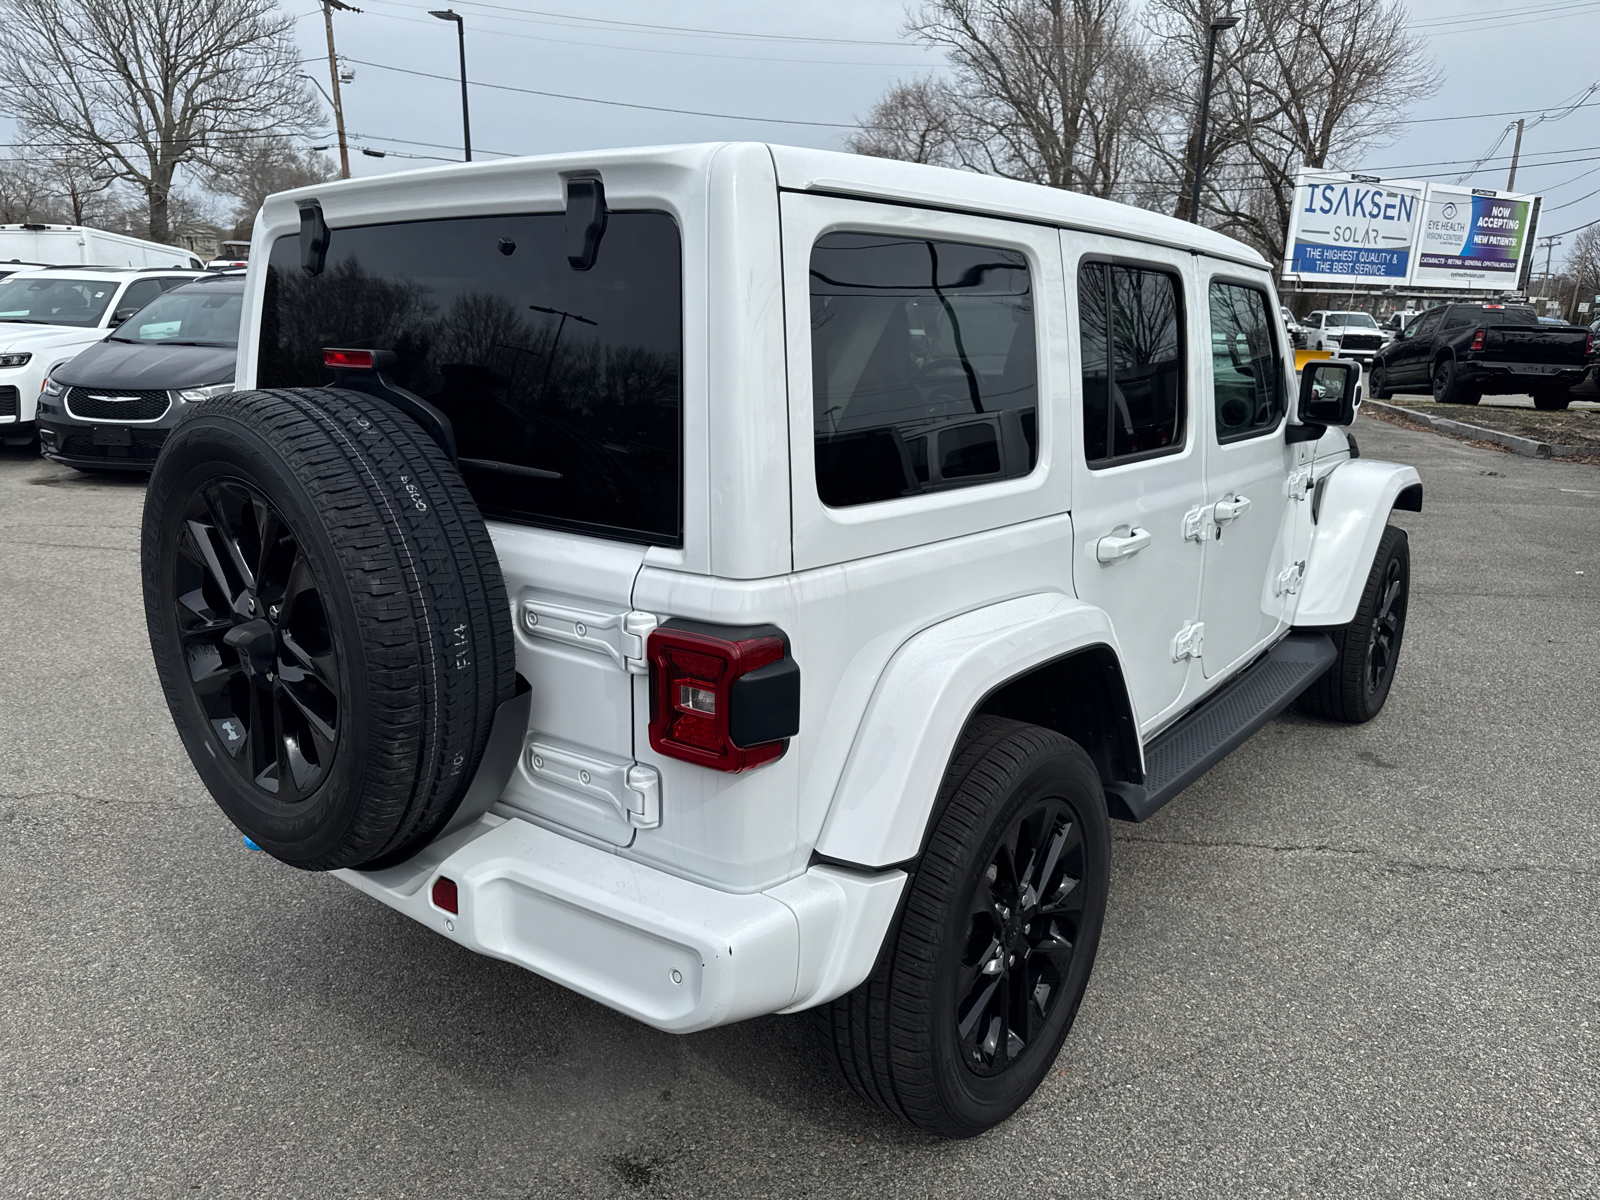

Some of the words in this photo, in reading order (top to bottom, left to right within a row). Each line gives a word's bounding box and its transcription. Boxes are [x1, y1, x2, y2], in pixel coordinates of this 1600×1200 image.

[1304, 183, 1414, 222] ISAKSEN
[1492, 207, 1511, 218] NOW
[1428, 220, 1440, 230] EYE
[1441, 221, 1465, 232] HEALTH
[1477, 217, 1519, 230] ACCEPTING
[1333, 225, 1379, 244] SOLAR
[1426, 232, 1442, 240] VISION
[1442, 234, 1464, 242] CENTERS
[1473, 235, 1488, 244] NEW
[1489, 236, 1517, 246] PATIENTS!
[1306, 247, 1322, 259] THE
[1323, 249, 1358, 261] HIGHEST
[1359, 251, 1391, 263] QUALITY
[1392, 254, 1398, 264] &
[1315, 261, 1331, 272] THE
[1332, 262, 1353, 273] BEST
[1354, 263, 1386, 275] SERVICE
